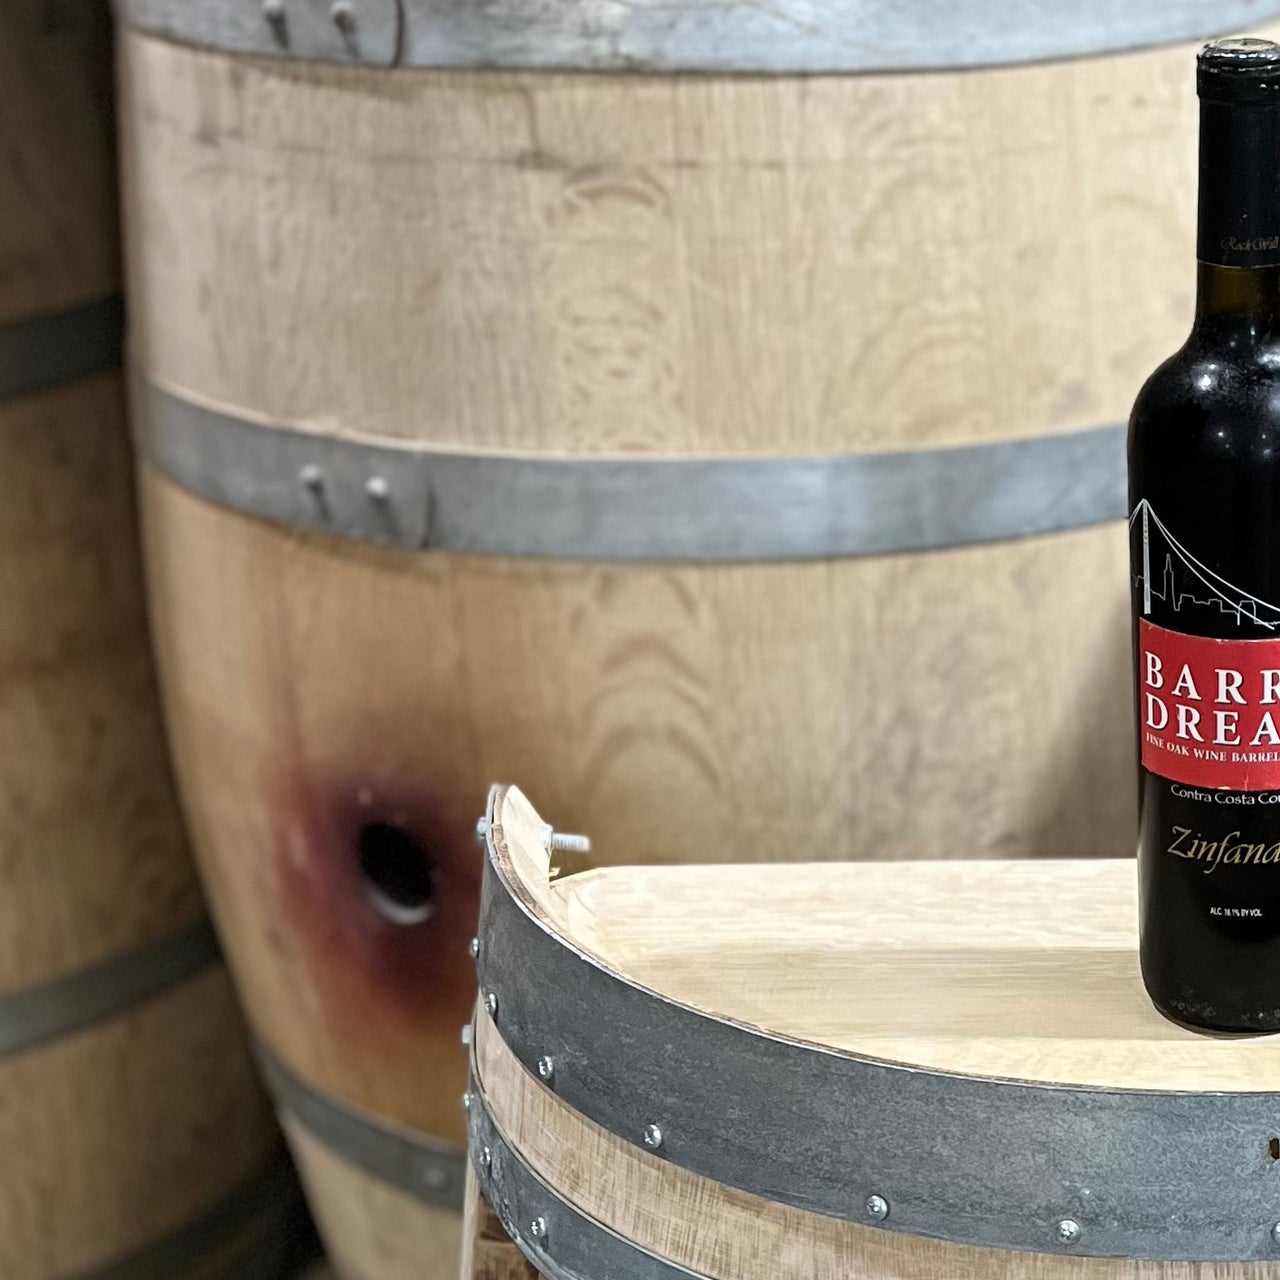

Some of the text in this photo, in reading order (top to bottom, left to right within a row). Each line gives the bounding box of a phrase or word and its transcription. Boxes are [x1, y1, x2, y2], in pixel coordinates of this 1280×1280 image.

[1166, 741, 1190, 757] OAK
[1193, 747, 1227, 762] WINE
[1170, 784, 1212, 803] Contra
[1214, 791, 1255, 805] Costa
